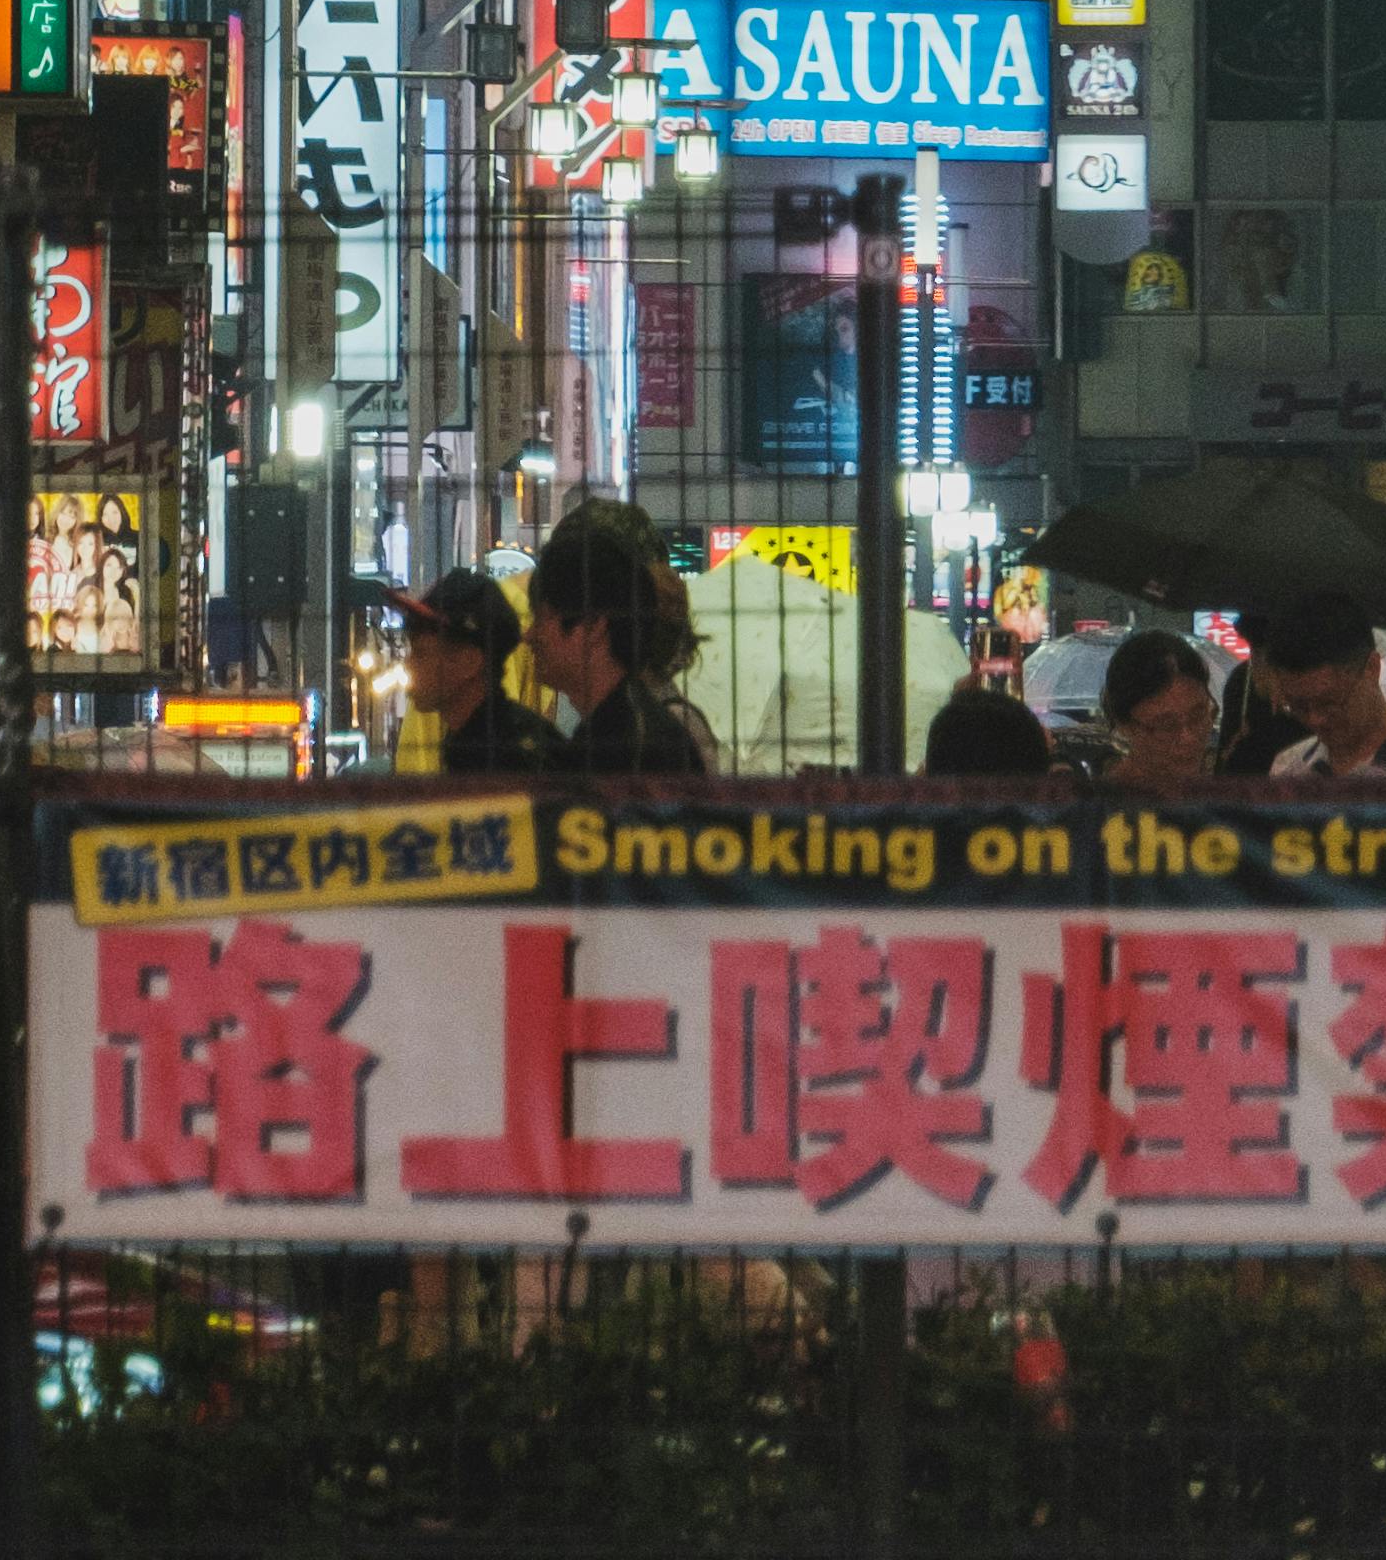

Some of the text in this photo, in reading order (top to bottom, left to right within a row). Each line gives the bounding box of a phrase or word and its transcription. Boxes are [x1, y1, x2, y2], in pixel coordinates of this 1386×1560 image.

[732, 7, 1046, 108] SAUNA
[94, 813, 516, 909] 新宿区内全域
[554, 807, 939, 893] Smoking
[964, 820, 1071, 877] on
[1099, 810, 1242, 878] the
